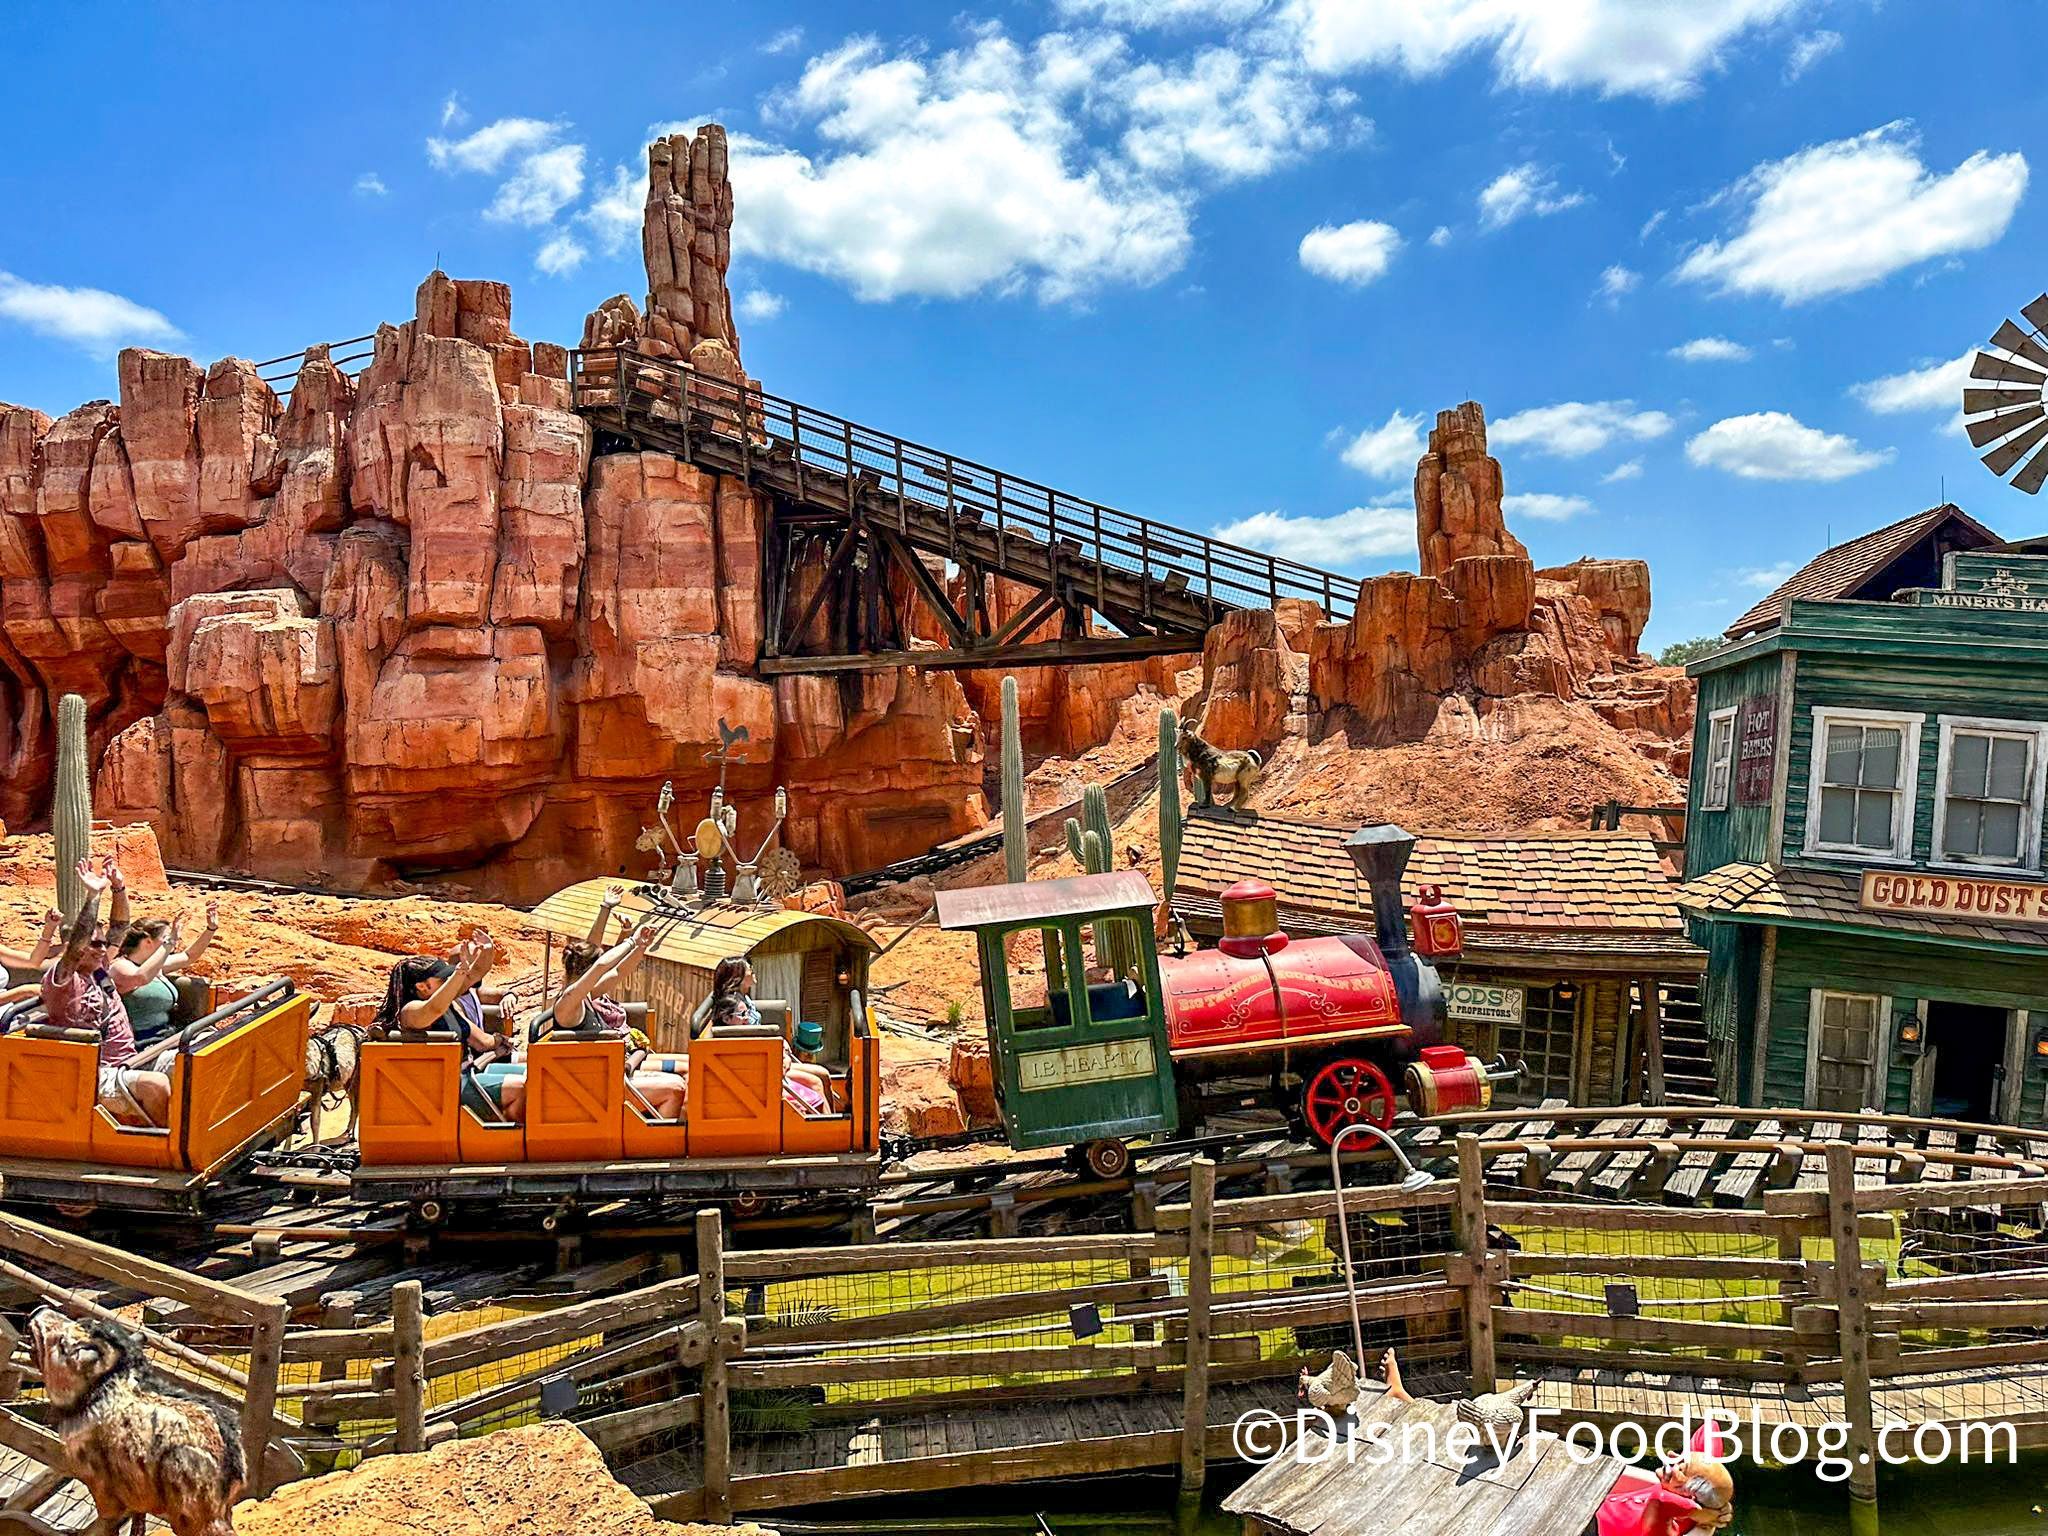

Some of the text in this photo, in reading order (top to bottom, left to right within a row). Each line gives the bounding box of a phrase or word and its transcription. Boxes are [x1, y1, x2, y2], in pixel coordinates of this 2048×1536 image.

[1932, 594, 2016, 609] MINER'S
[1747, 710, 1770, 734] HOT
[1741, 735, 1773, 761] BATHS
[1873, 876, 1949, 908] GOLD
[1955, 882, 2034, 916] DUST
[1441, 985, 1505, 1007] OODS
[1457, 1005, 1511, 1018] PROPRIETORS
[1063, 1049, 1140, 1075] HEARTY
